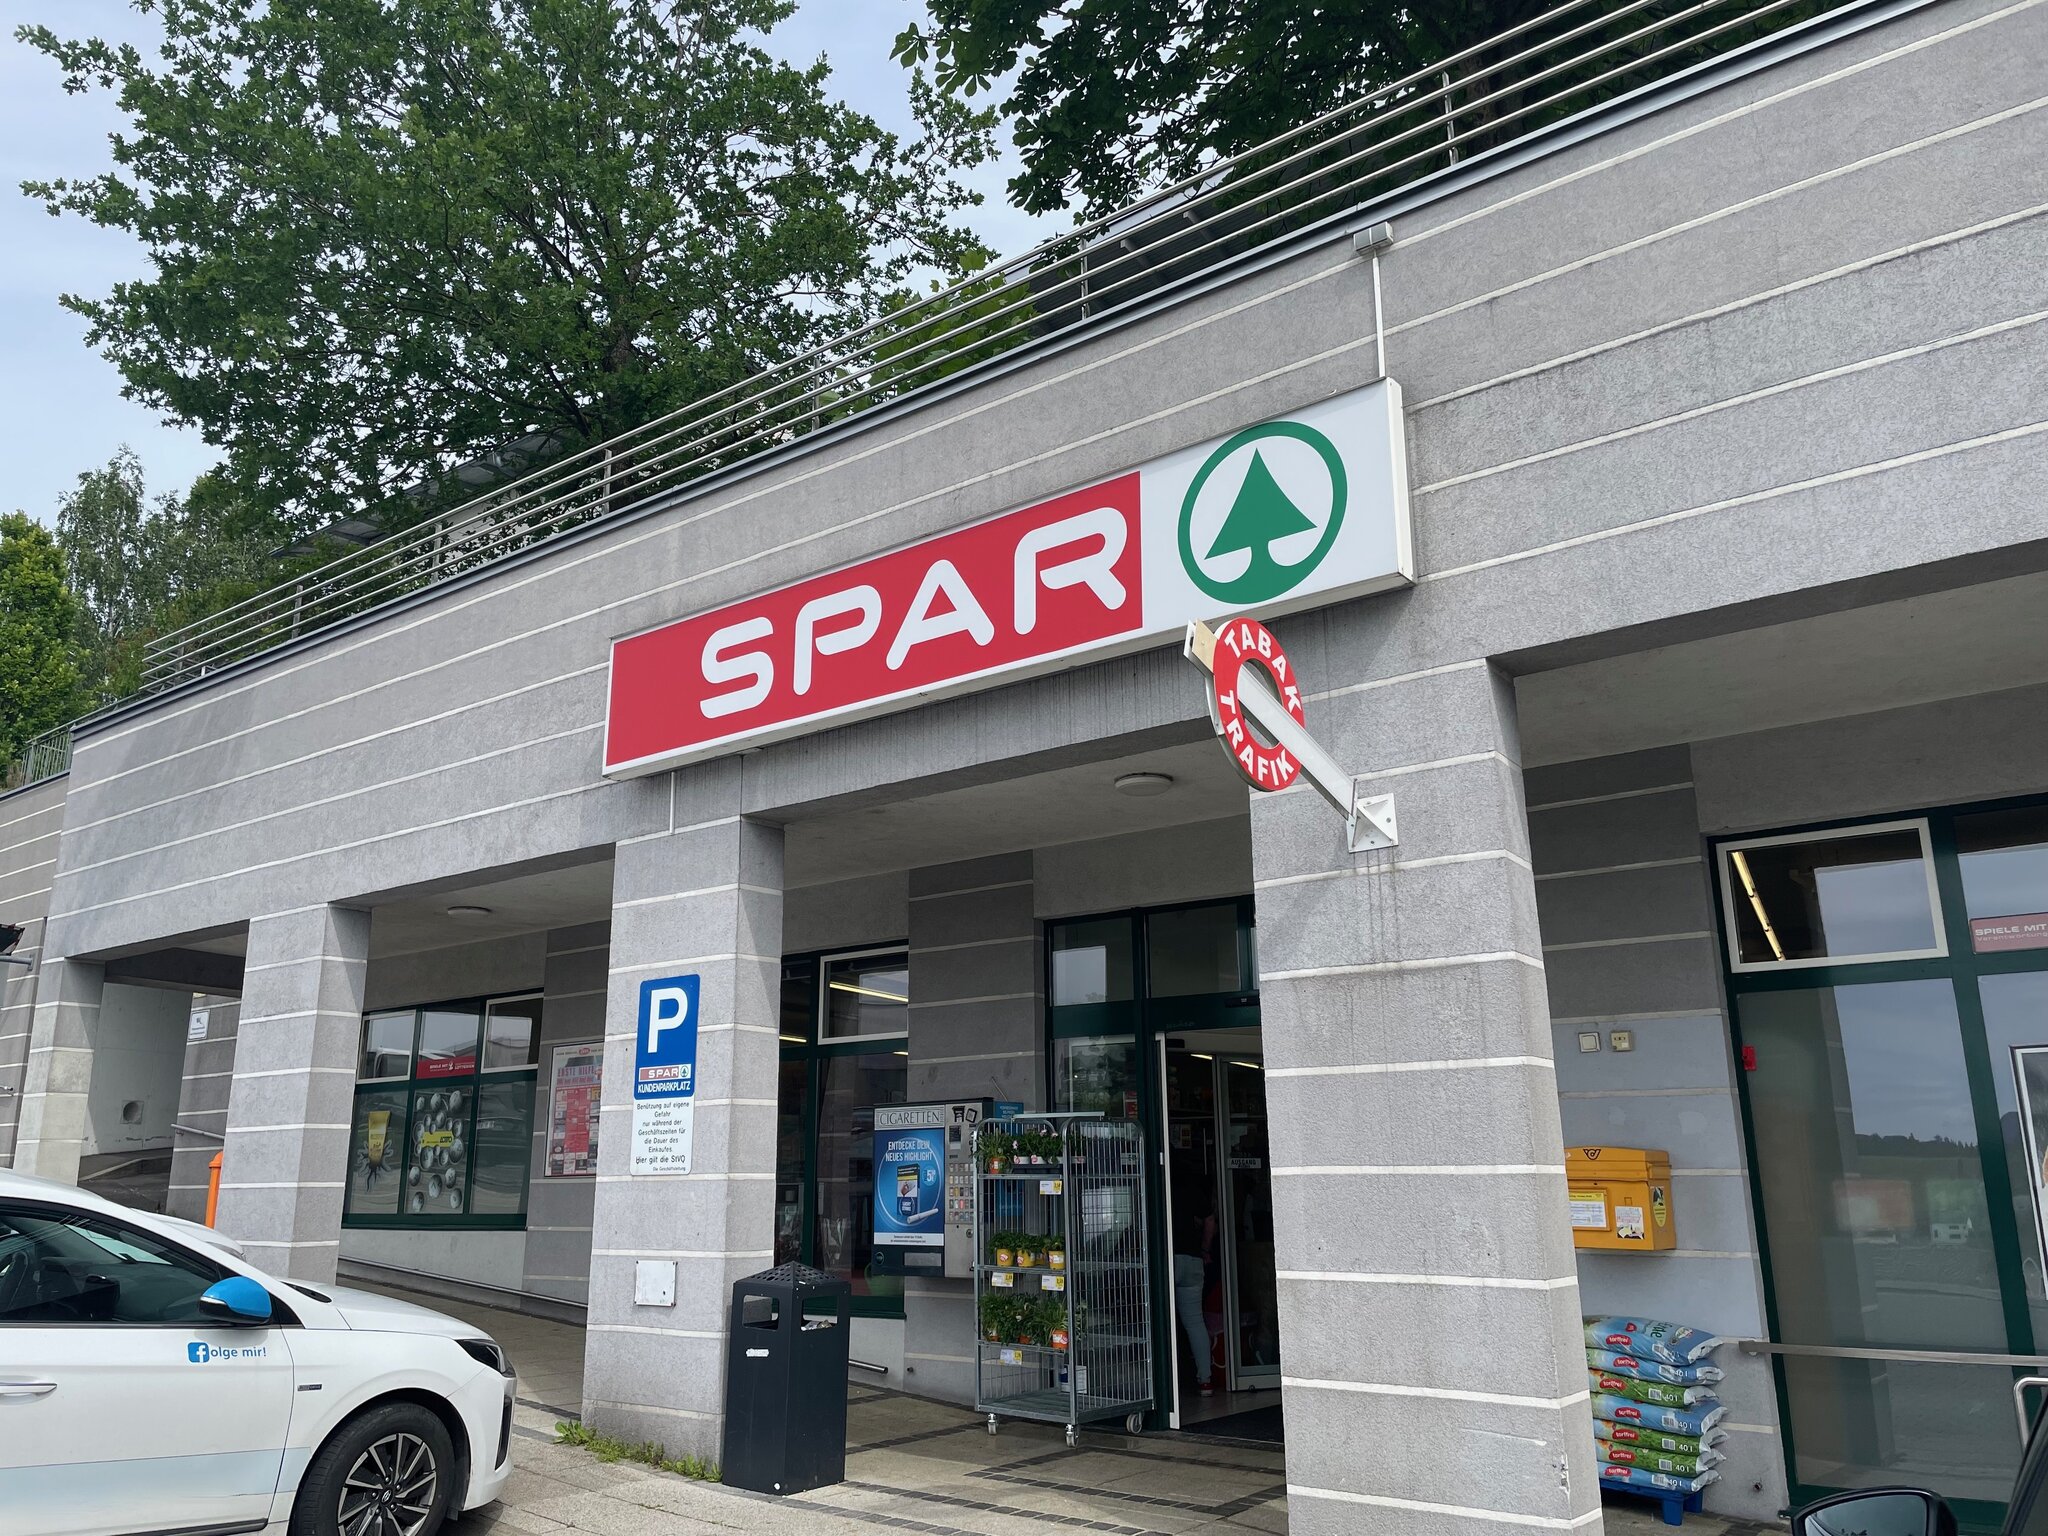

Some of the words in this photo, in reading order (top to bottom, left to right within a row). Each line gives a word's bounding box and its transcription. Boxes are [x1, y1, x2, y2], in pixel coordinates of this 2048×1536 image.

[700, 507, 1128, 719] SPAR
[1224, 623, 1302, 713] TABAK
[1220, 689, 1294, 786] TRAFIK
[1975, 926, 2019, 936] SPIELE
[2024, 923, 2047, 932] MIT
[647, 987, 688, 1053] P
[648, 1067, 679, 1078] SPAR
[637, 1081, 691, 1094] KUNDENPARKPLATZ
[879, 1110, 941, 1125] CIGARETTEN
[888, 1140, 916, 1151] ENTDECKE
[885, 1152, 904, 1162] NEUES
[904, 1151, 933, 1161] HIGHLIGHT
[242, 1346, 267, 1357] mir!
[1679, 1421, 1688, 1429] 40
[1679, 1444, 1688, 1452] 40
